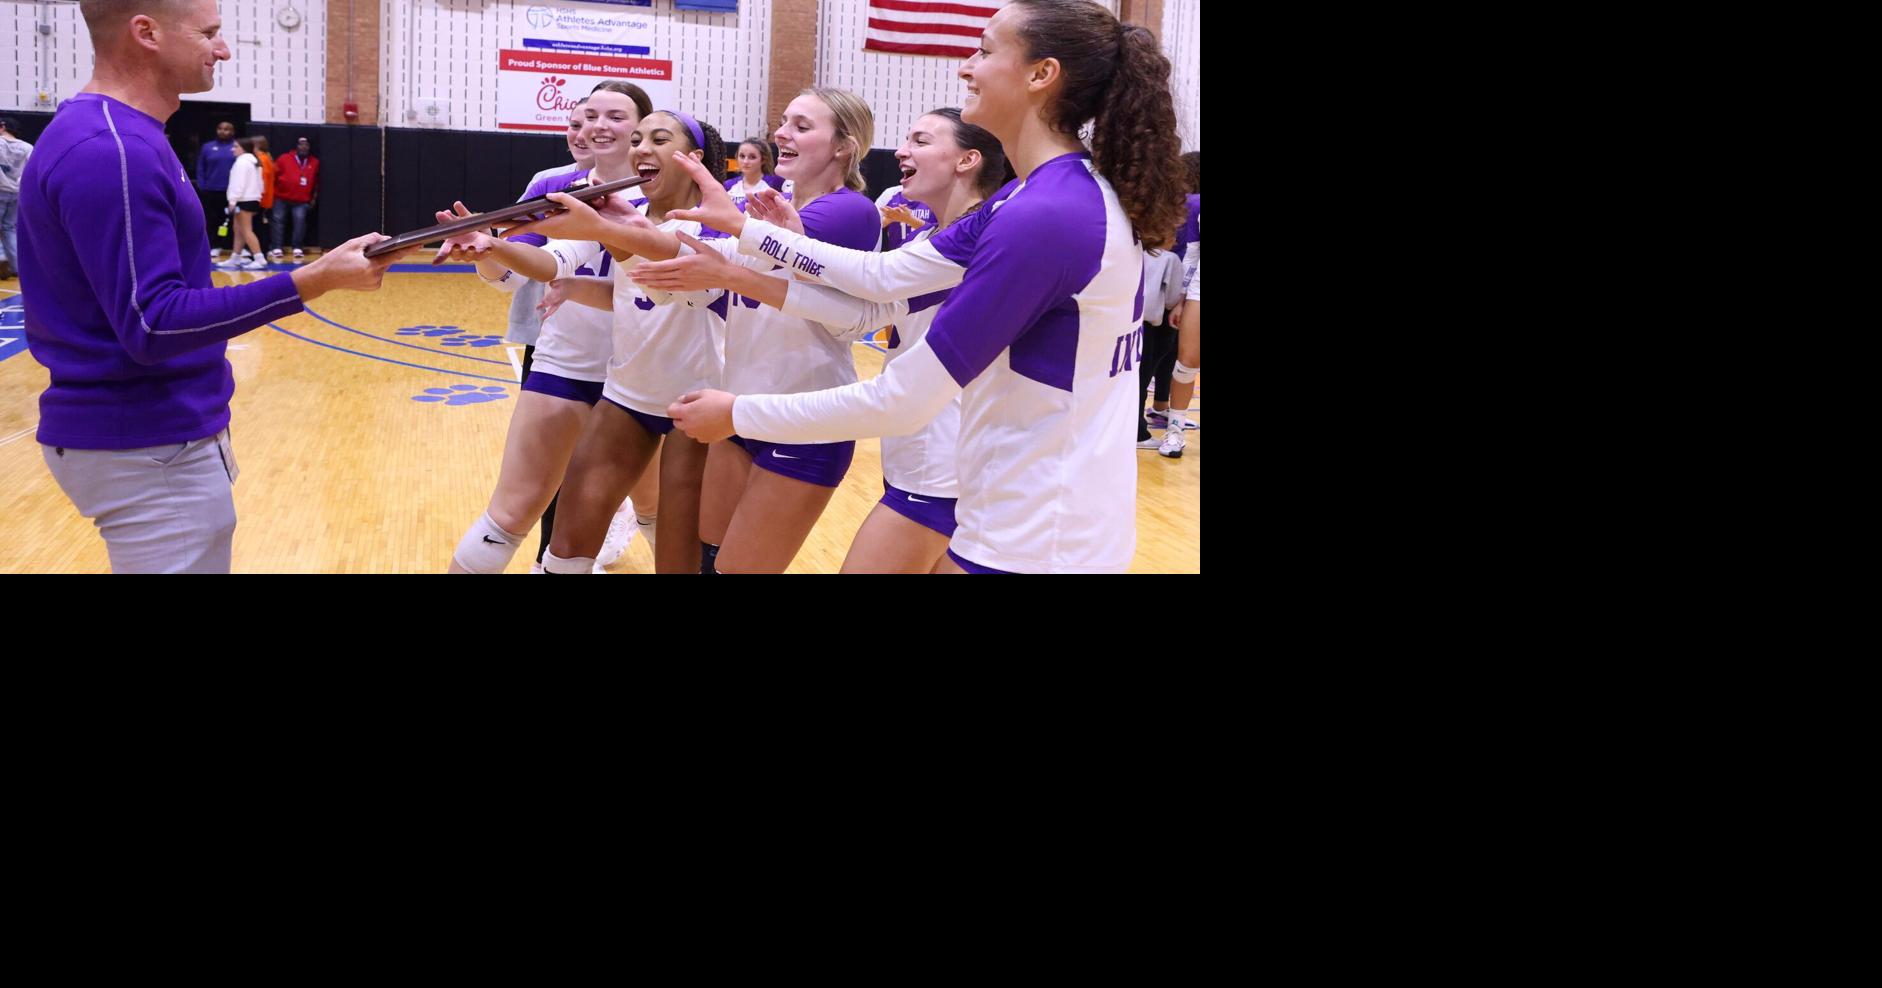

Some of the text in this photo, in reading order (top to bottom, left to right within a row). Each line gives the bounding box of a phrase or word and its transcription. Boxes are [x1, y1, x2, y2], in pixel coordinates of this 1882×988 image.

[556, 15, 648, 29] Athletes Advantage
[556, 22, 612, 33] Sports Medicine
[508, 58, 665, 76] Proud Sponsor of Blue Storm Athletics
[535, 113, 563, 122] Green
[759, 235, 825, 277] ROLL TRIBE
